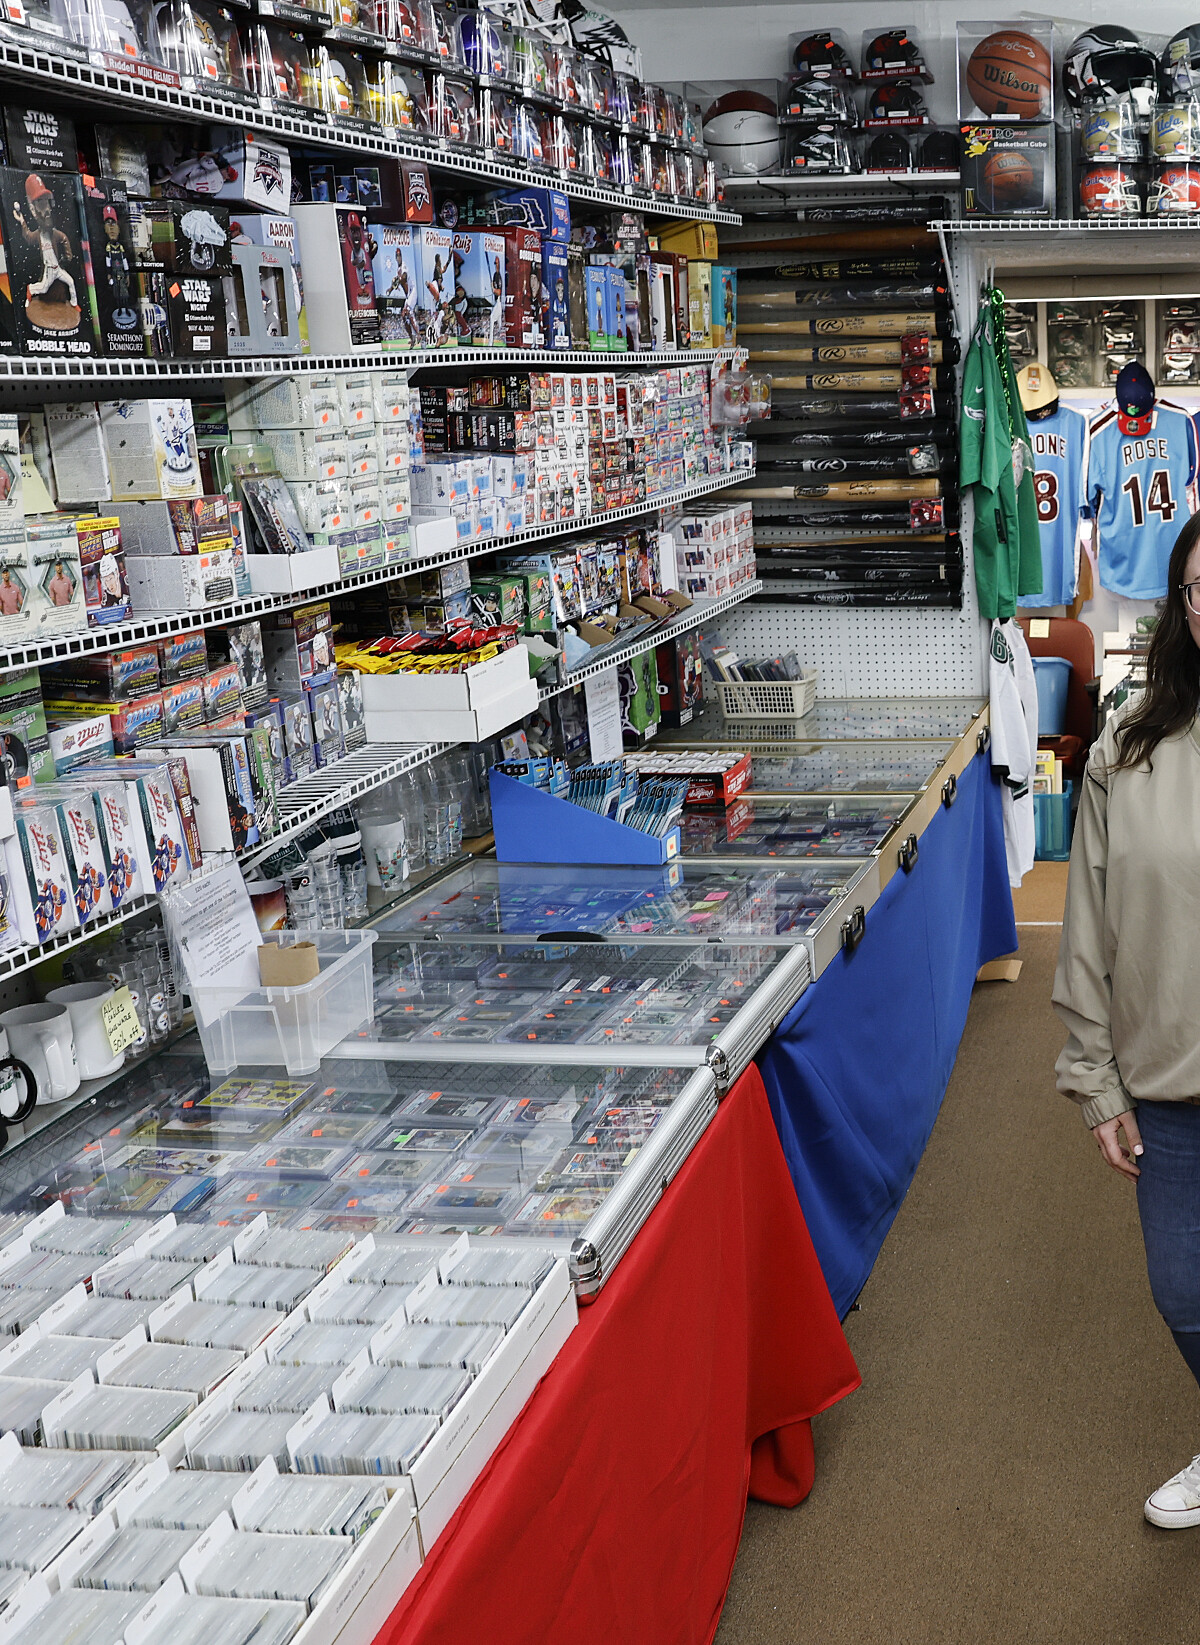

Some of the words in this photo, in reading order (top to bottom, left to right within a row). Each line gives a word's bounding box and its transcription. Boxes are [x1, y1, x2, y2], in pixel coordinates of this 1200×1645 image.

[291, 10, 311, 21] HELMET
[351, 34, 369, 44] HELMET
[138, 64, 152, 79] MINI
[153, 68, 175, 85] HELMET
[984, 63, 1040, 95] Wilson
[215, 87, 237, 99] HELMET
[23, 110, 58, 126] STAR
[288, 106, 307, 117] HELMET
[25, 121, 59, 137] WARS
[346, 120, 364, 130] HELMET
[994, 140, 1028, 148] Basketball
[1030, 140, 1047, 148] Cube
[269, 222, 295, 238] AARON
[383, 228, 410, 246] 2004-2005
[453, 234, 473, 254] Ruiz
[181, 279, 211, 292] STAR
[183, 290, 212, 303] WARS
[190, 303, 208, 312] NIGHT
[107, 333, 144, 342] SERANTHONY
[27, 339, 66, 353] BOBBLE
[67, 341, 91, 353] HEAD
[109, 342, 144, 351] DOMINGUEZ
[1122, 438, 1170, 467] ROSE
[1122, 468, 1178, 528] 14
[201, 569, 234, 580] ARTIFACTS
[180, 558, 192, 607] ARTIFACTS
[103, 1001, 114, 1016] ALL
[108, 1004, 125, 1023] EAGLES
[113, 1031, 127, 1052] 50%
